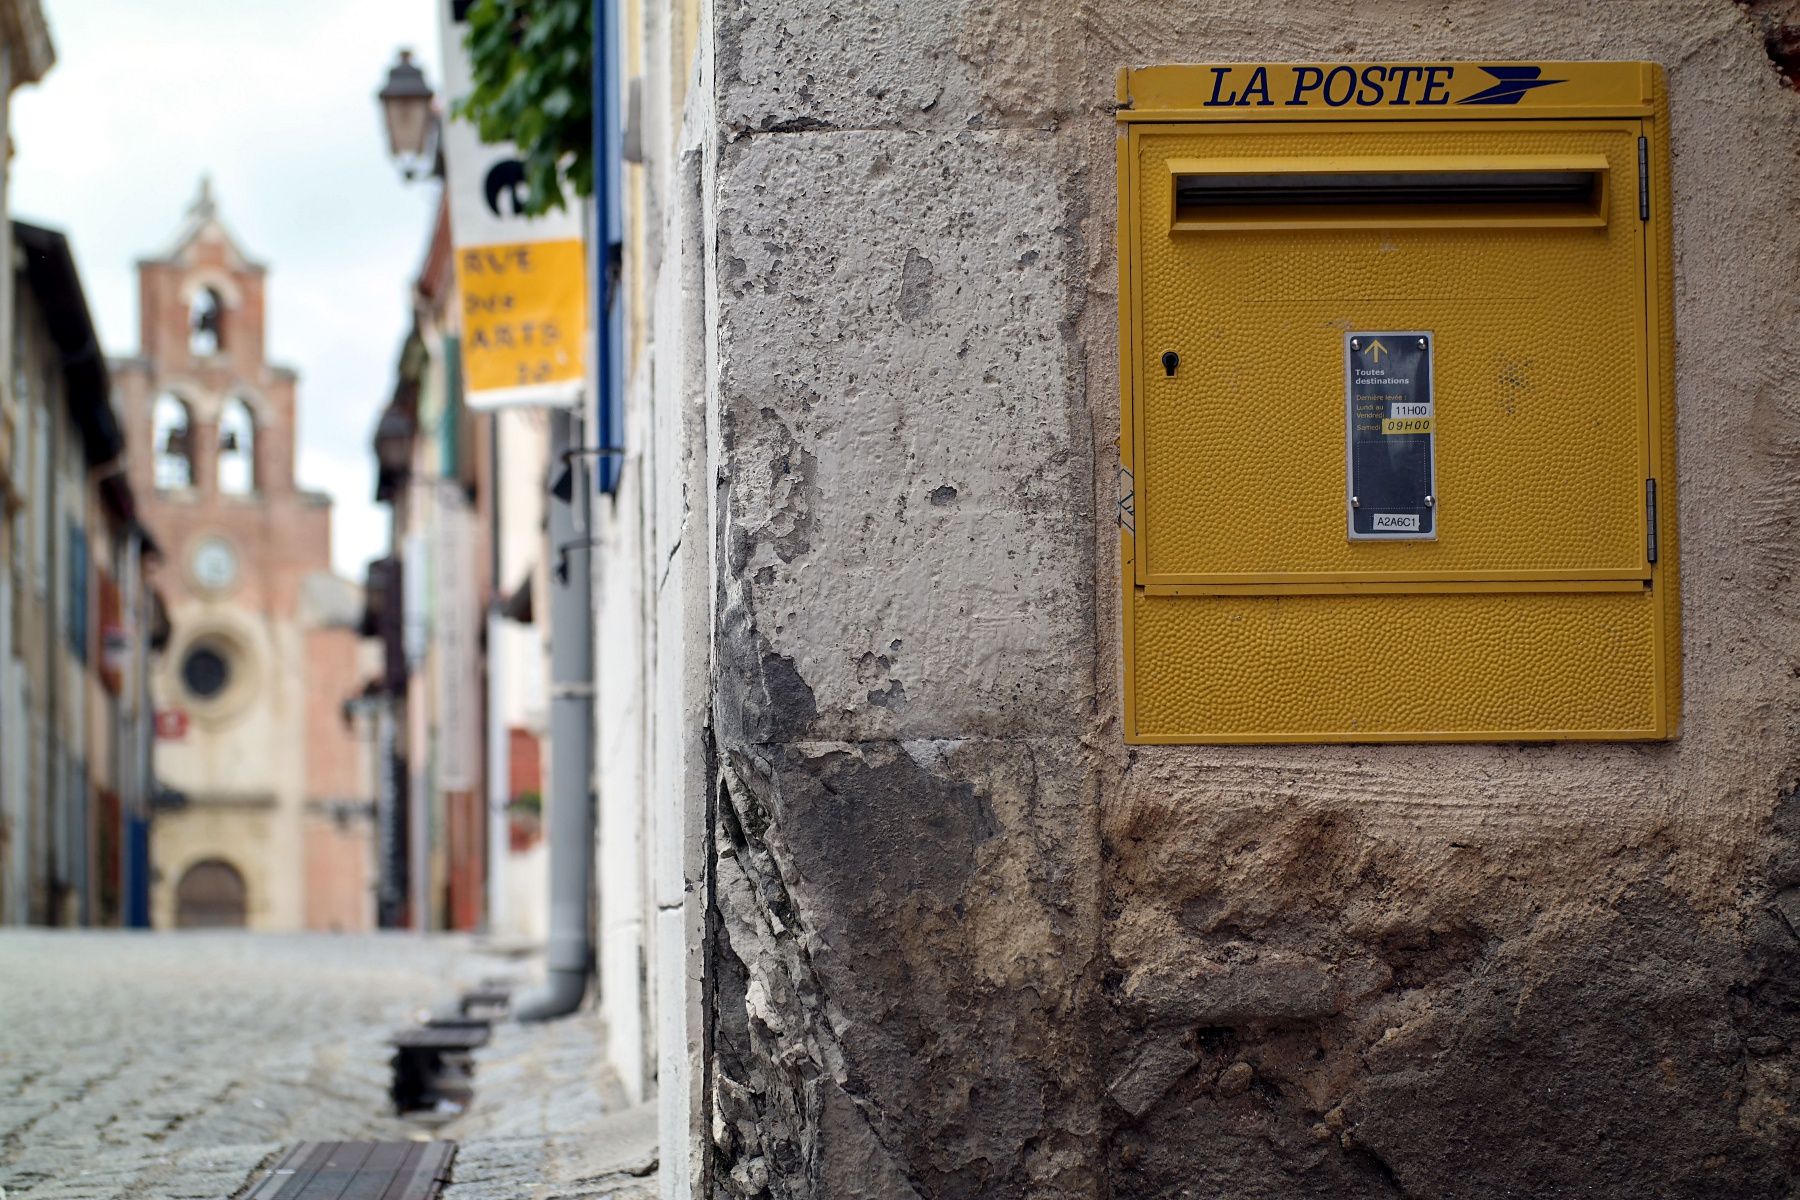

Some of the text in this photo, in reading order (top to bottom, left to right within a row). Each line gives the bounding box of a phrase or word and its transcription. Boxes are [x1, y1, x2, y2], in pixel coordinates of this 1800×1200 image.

[1203, 65, 1455, 107] LA POSTE
[1355, 368, 1385, 376] Toutes
[1355, 377, 1410, 385] destinations
[1395, 405, 1427, 416] 11H00
[1387, 420, 1430, 431] 09H00
[1377, 516, 1416, 527] A2A6C1
